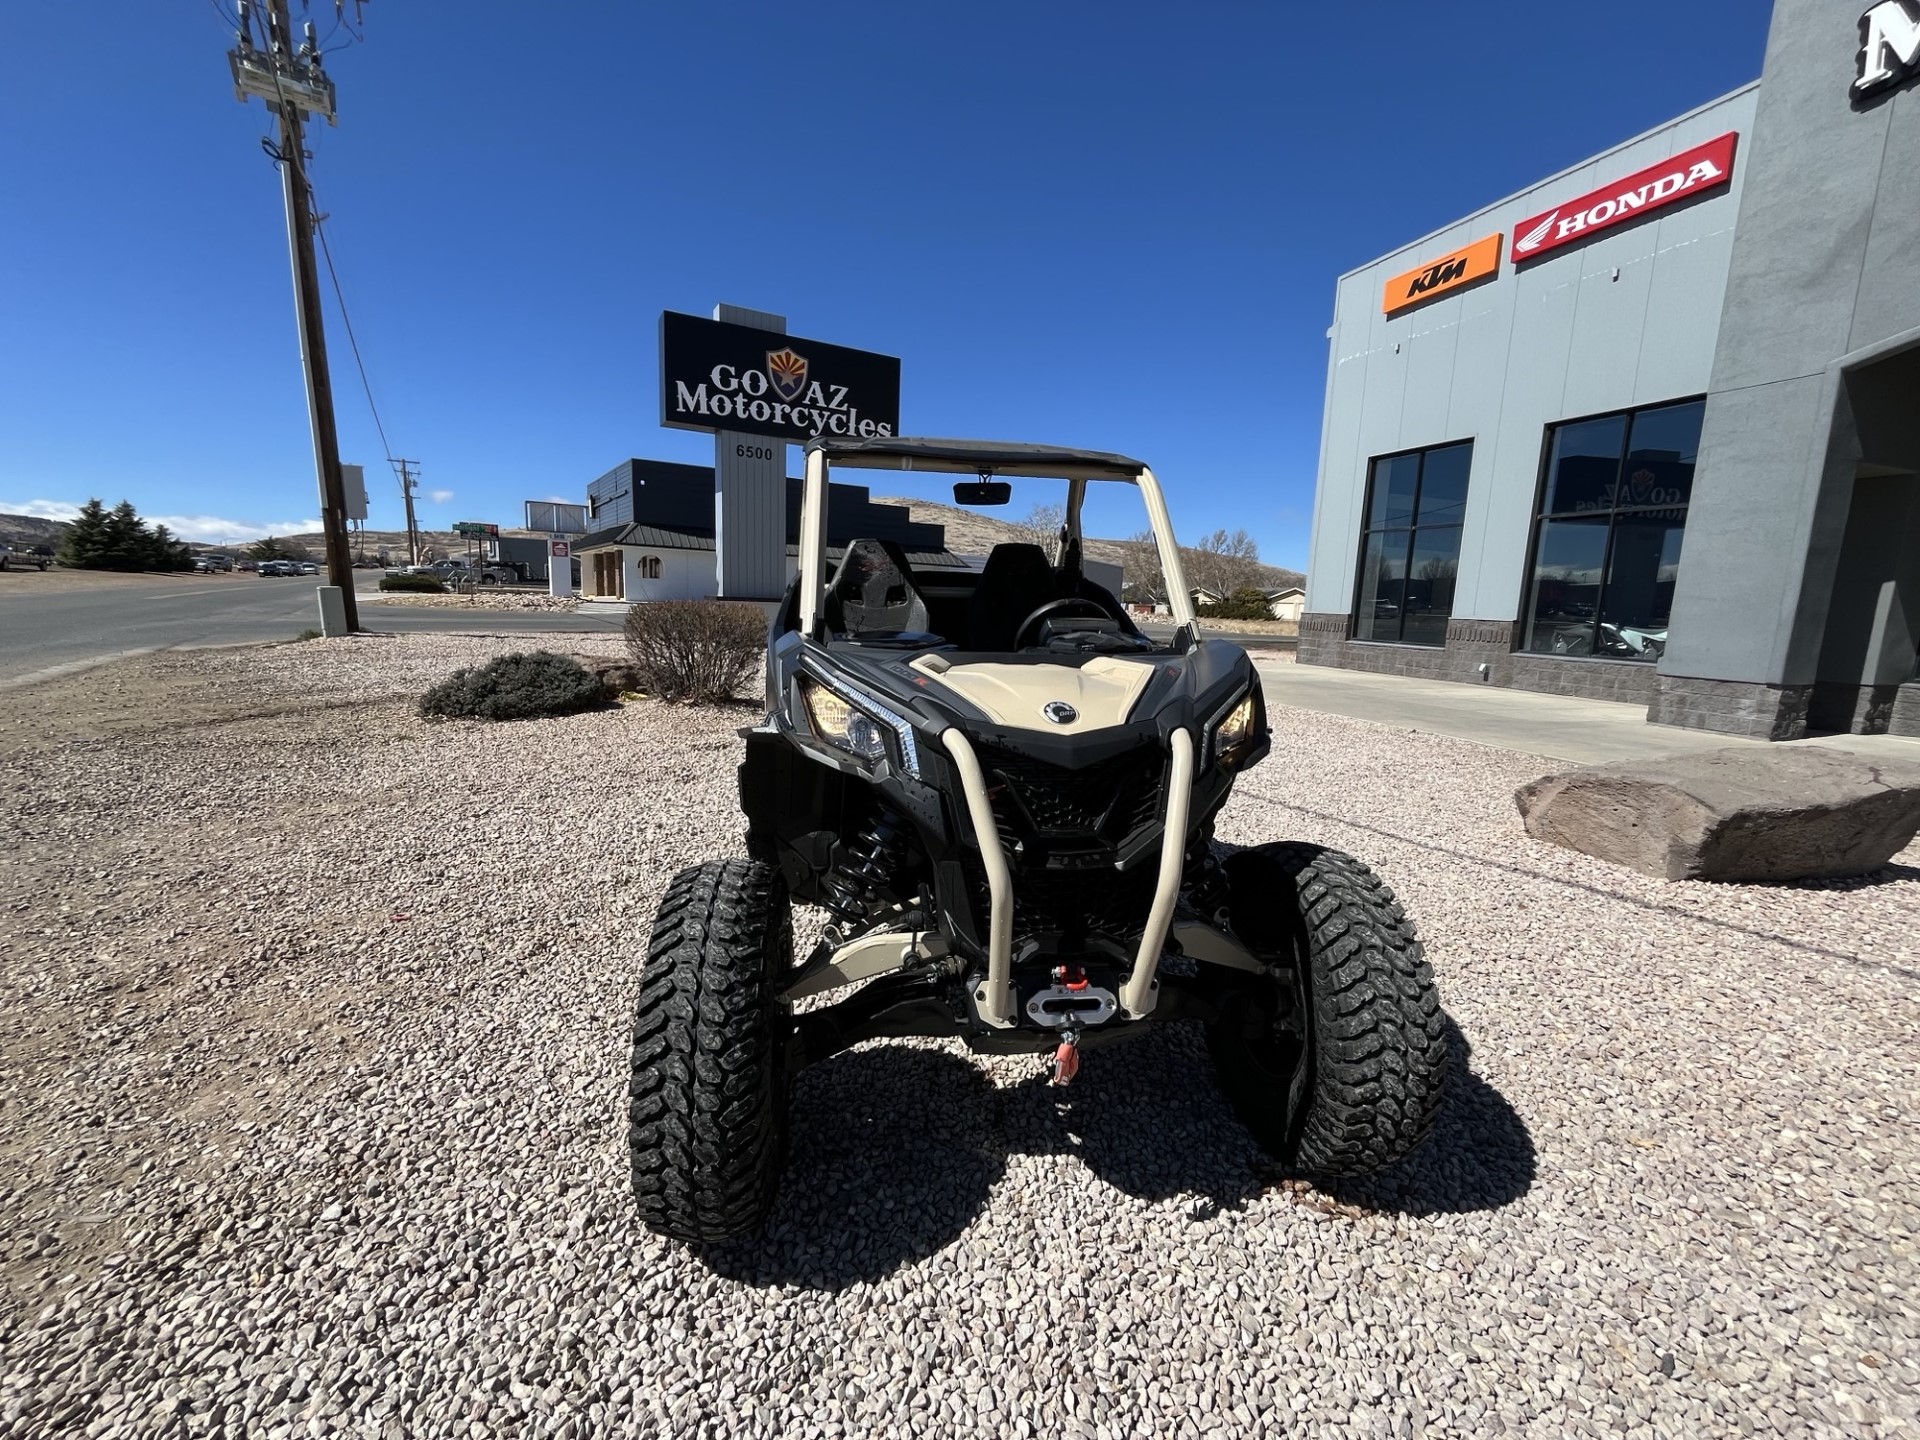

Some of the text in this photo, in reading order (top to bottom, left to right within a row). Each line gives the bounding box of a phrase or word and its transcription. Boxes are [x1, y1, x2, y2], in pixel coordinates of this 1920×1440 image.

[1555, 160, 1722, 240] HONDA
[1406, 257, 1468, 299] KTM
[675, 380, 892, 438] Motorcycles
[709, 364, 849, 411] GO AZ
[736, 444, 773, 461] 6500
